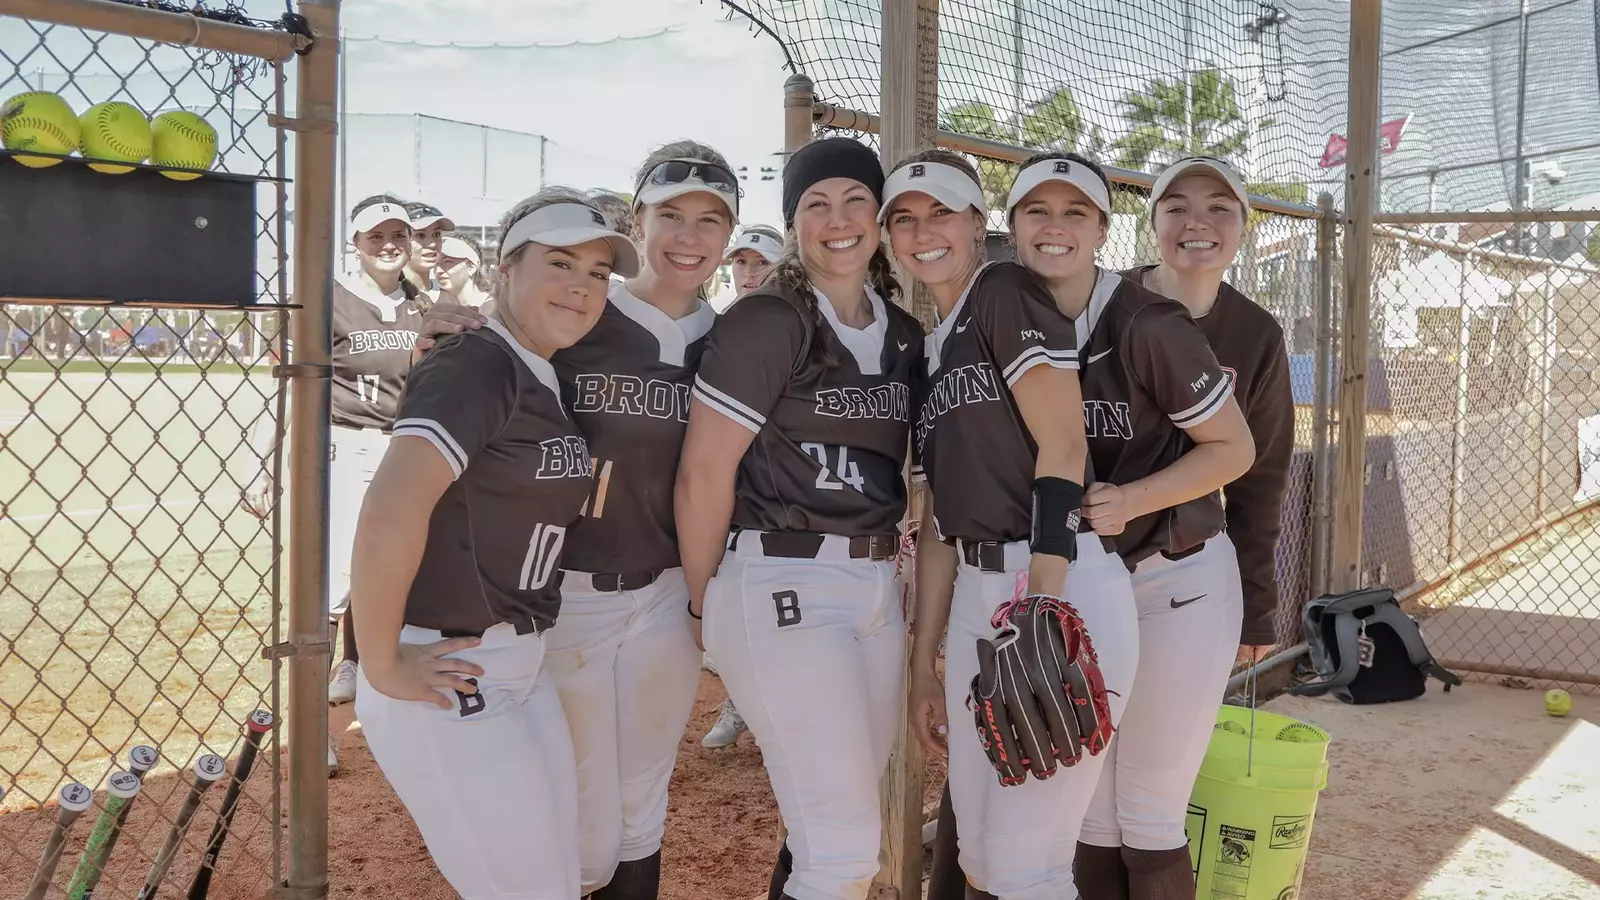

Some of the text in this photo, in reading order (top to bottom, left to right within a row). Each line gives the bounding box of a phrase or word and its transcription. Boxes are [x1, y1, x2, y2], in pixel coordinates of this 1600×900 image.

[909, 164, 926, 179] B
[1053, 161, 1070, 175] B
[382, 205, 390, 213] B
[588, 209, 606, 227] B
[750, 234, 760, 243] B
[357, 374, 379, 404] 17
[1190, 375, 1207, 393] Ivy
[801, 442, 864, 494] 24
[518, 523, 566, 590] 10
[772, 590, 802, 627] B
[455, 677, 486, 717] B
[256, 711, 269, 719] 23
[207, 757, 218, 766] 17
[72, 785, 84, 795] 14
[1226, 826, 1255, 837] WARNING
